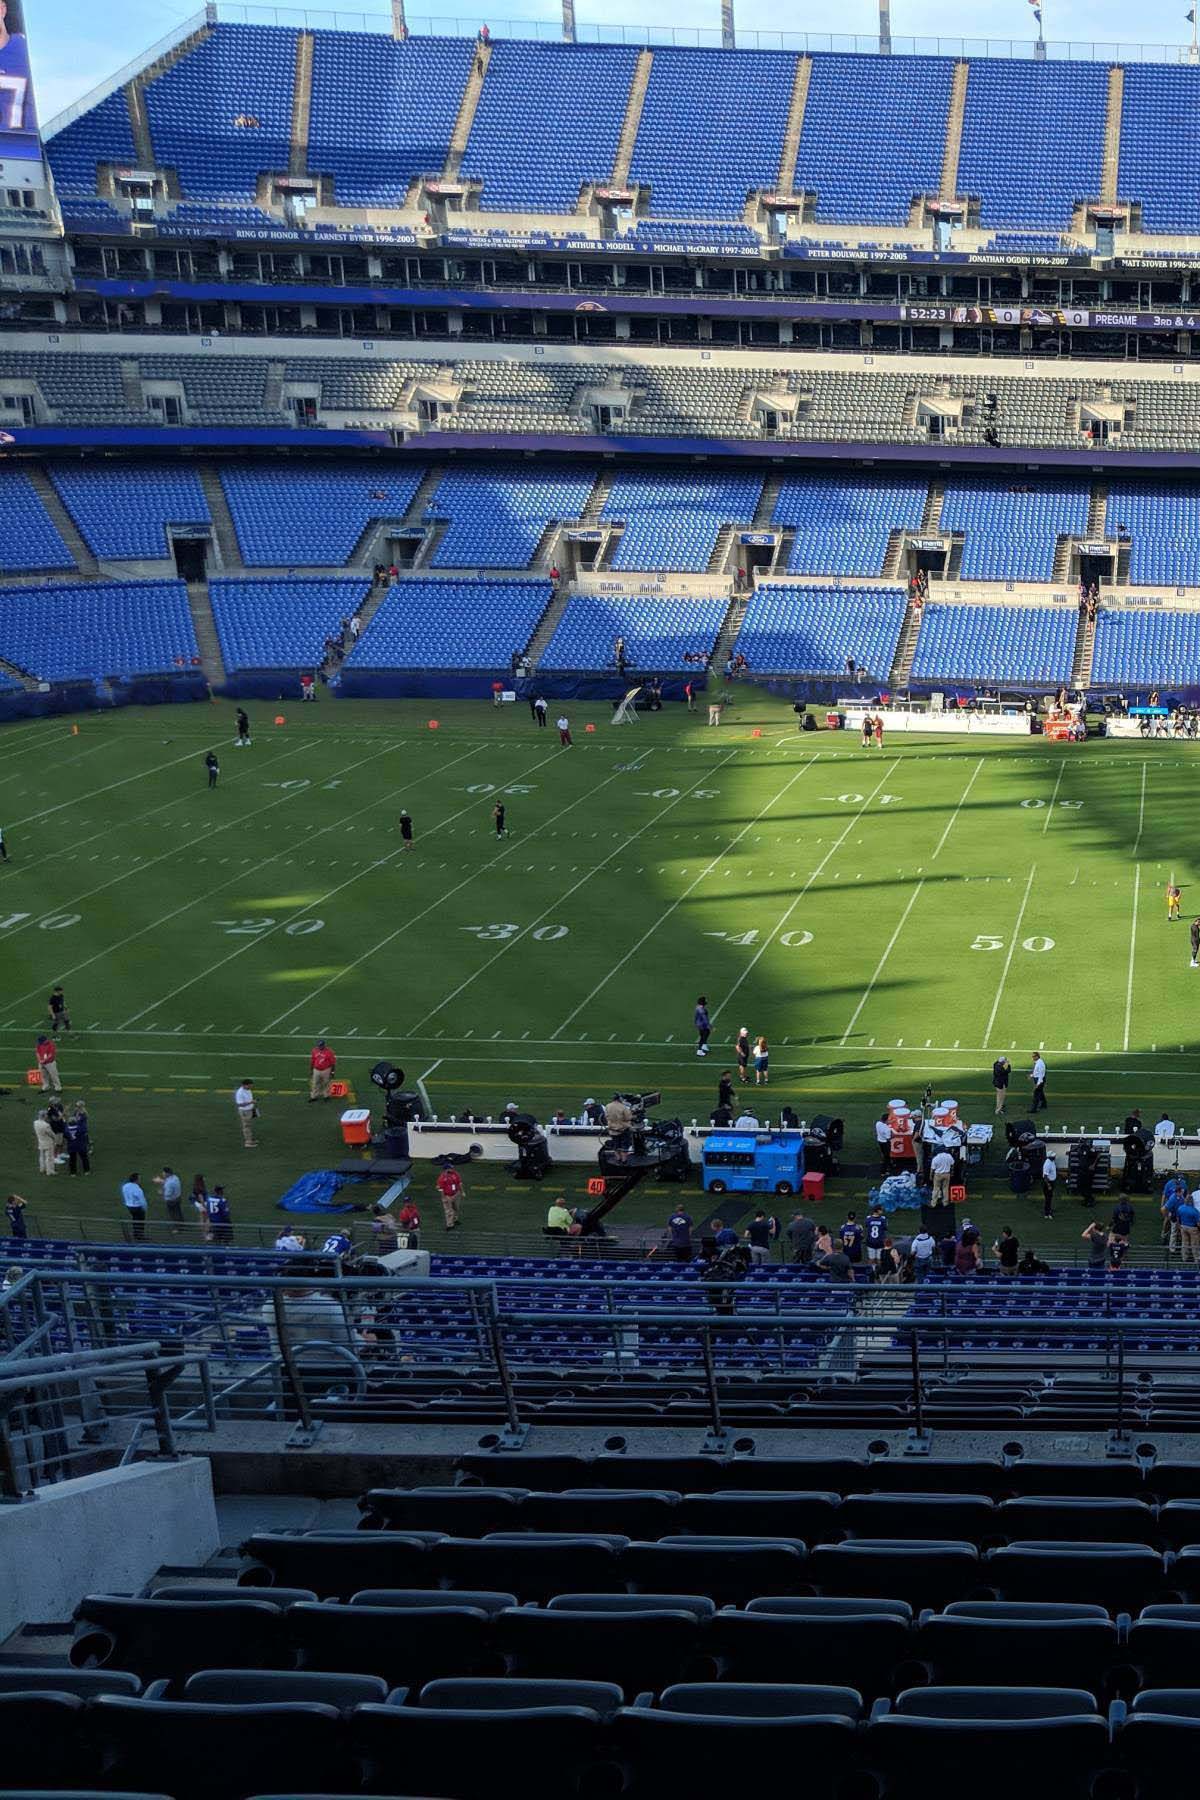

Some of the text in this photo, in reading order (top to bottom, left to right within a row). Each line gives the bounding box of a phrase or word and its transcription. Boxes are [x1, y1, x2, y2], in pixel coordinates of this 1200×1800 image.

[161, 227, 201, 236] SMYTH
[236, 230, 299, 240] RING OF HONOR
[314, 232, 415, 244] EARNEST BYNER 1996-2003
[567, 241, 595, 249] ARTHUR
[606, 242, 635, 251] MODELL
[653, 244, 759, 255] MICHAEL McCRARY 1997-2002
[808, 250, 907, 260] PETER BOULWARE 1997-2005
[968, 254, 1069, 265] JONATHAN OGDEN 1996-2007
[1121, 259, 1141, 268] MATT
[1142, 260, 1168, 268] STOVER
[910, 309, 1082, 324] 52:23 0 0
[1095, 314, 1137, 325] PREGAME
[1175, 316, 1184, 327] &
[1187, 317, 1195, 327] 4
[225, 918, 325, 935] 20
[475, 923, 571, 942] 30
[724, 929, 814, 947] 40
[970, 934, 1056, 952] 50
[28, 1070, 41, 1083] 20
[331, 1083, 343, 1095] 30
[890, 1136, 905, 1154] G
[590, 1180, 603, 1192] 40
[950, 1187, 964, 1201] 50
[209, 1202, 219, 1213] 15
[870, 1226, 879, 1238] 8
[323, 1240, 337, 1253] 52
